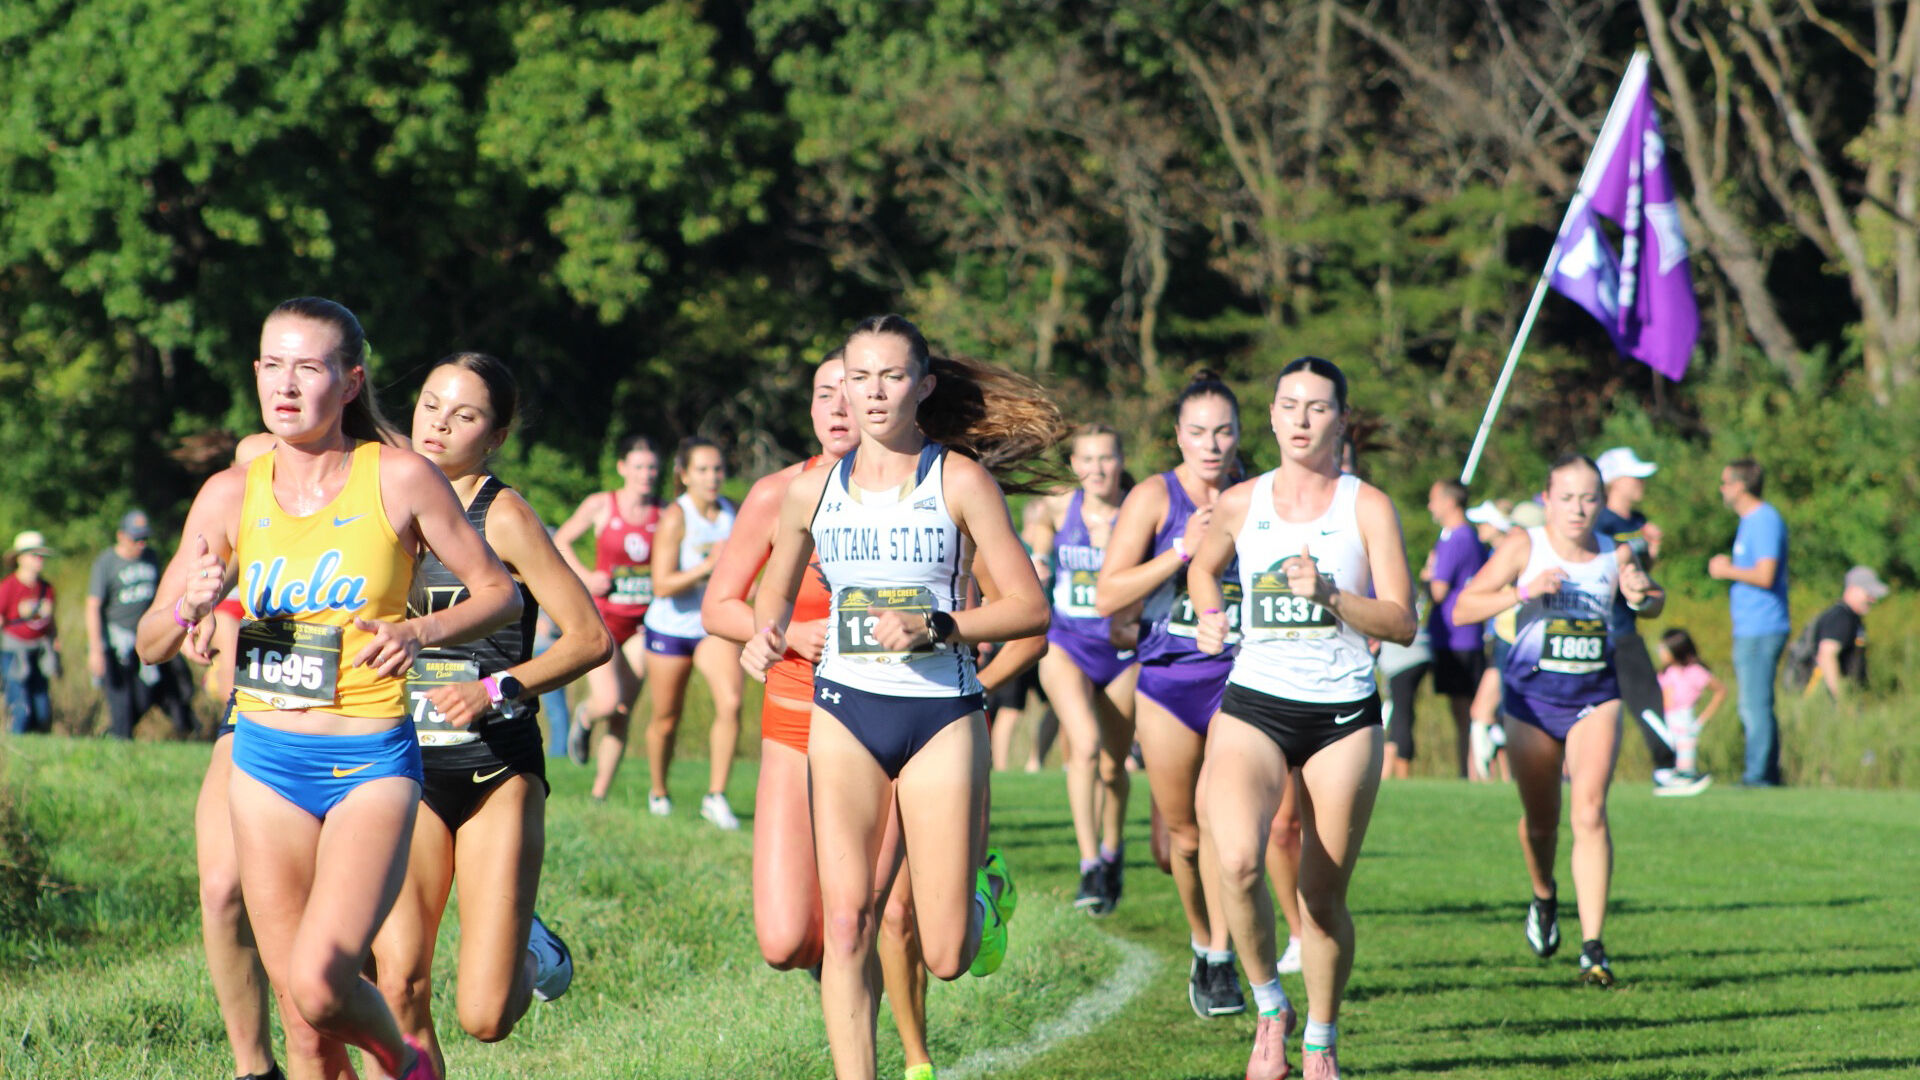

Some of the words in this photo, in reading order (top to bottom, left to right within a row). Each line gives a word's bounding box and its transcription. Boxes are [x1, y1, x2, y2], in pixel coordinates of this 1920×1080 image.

[890, 527, 945, 563] STATE
[1059, 544, 1106, 572] FURM
[245, 549, 368, 621] Ucla
[1260, 596, 1324, 622] 1337
[1550, 635, 1602, 659] 1803
[246, 647, 324, 690] 1695
